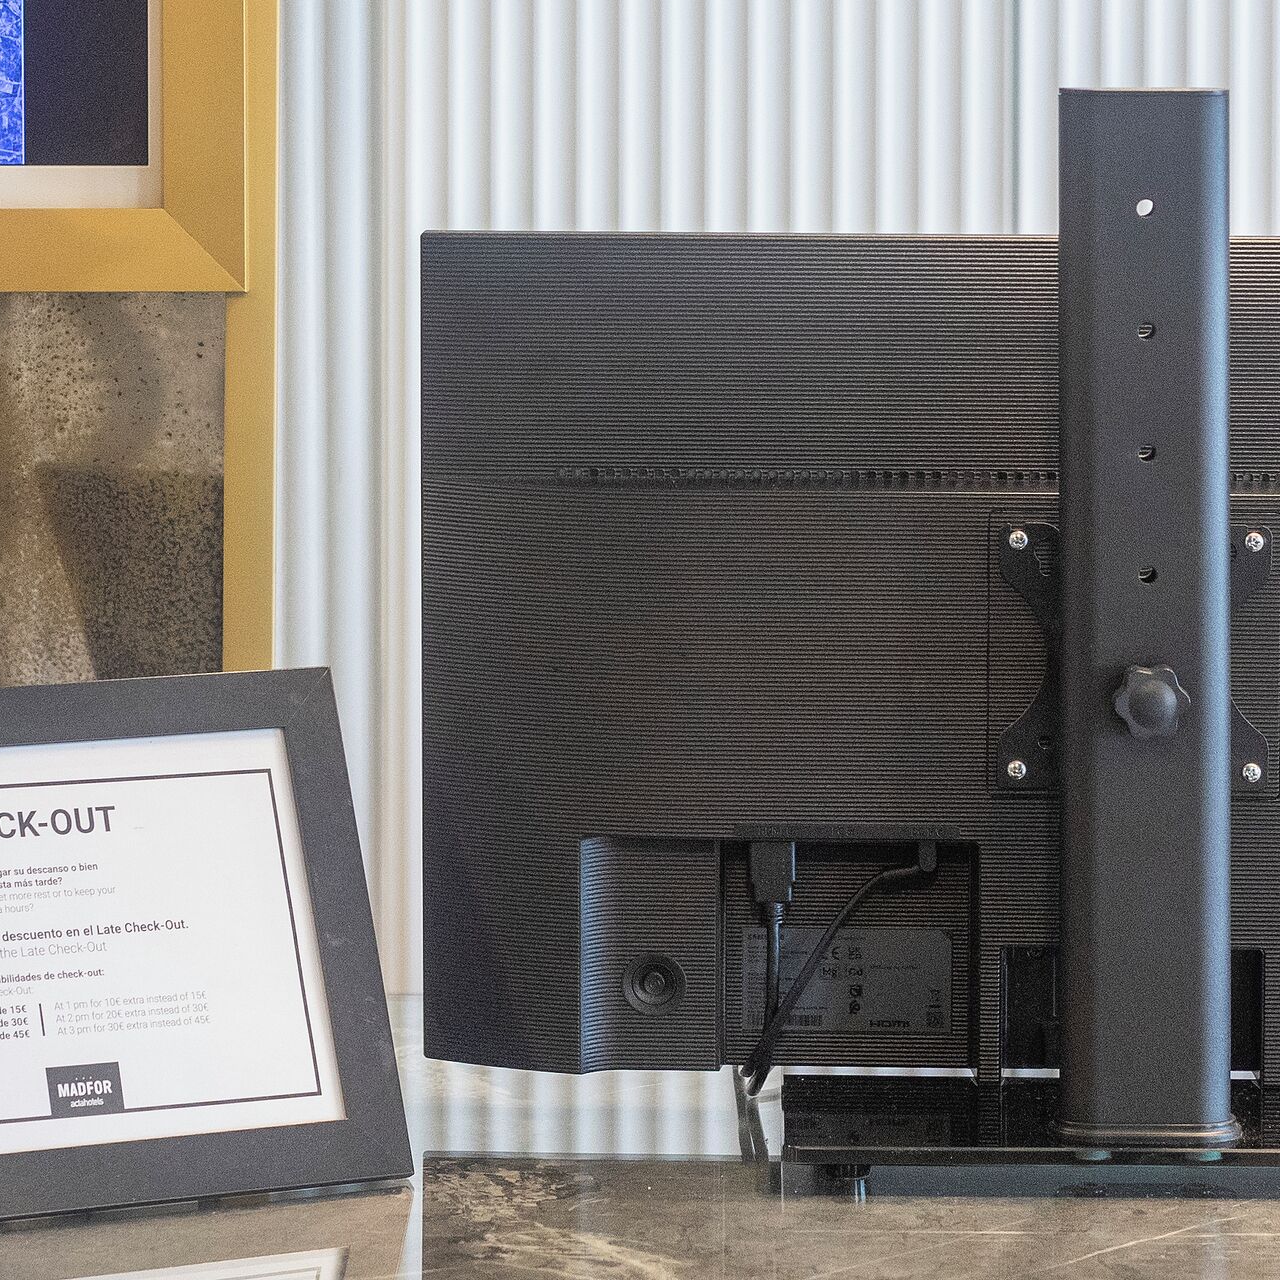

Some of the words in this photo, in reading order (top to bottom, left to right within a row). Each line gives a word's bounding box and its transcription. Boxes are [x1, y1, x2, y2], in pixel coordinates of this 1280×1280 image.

[26, 864, 69, 875] descanso
[79, 863, 98, 872] bien
[14, 879, 33, 888] más
[35, 877, 63, 886] tarde?
[1, 928, 63, 943] descuento
[66, 929, 81, 938] en
[83, 926, 94, 937] el
[96, 924, 122, 936] Late
[124, 919, 188, 934] Check-Out.
[0, 948, 18, 960] the
[20, 946, 46, 958] Late
[48, 942, 107, 957] Check-Out
[43, 971, 55, 981] de
[57, 968, 104, 980] check-out:
[10, 1006, 27, 1015] 15€
[11, 1019, 28, 1027] 30€
[0, 1033, 11, 1041] de
[13, 1032, 30, 1040] 45€
[57, 1079, 113, 1098] MADFOR
[70, 1097, 105, 1108] actahotels
